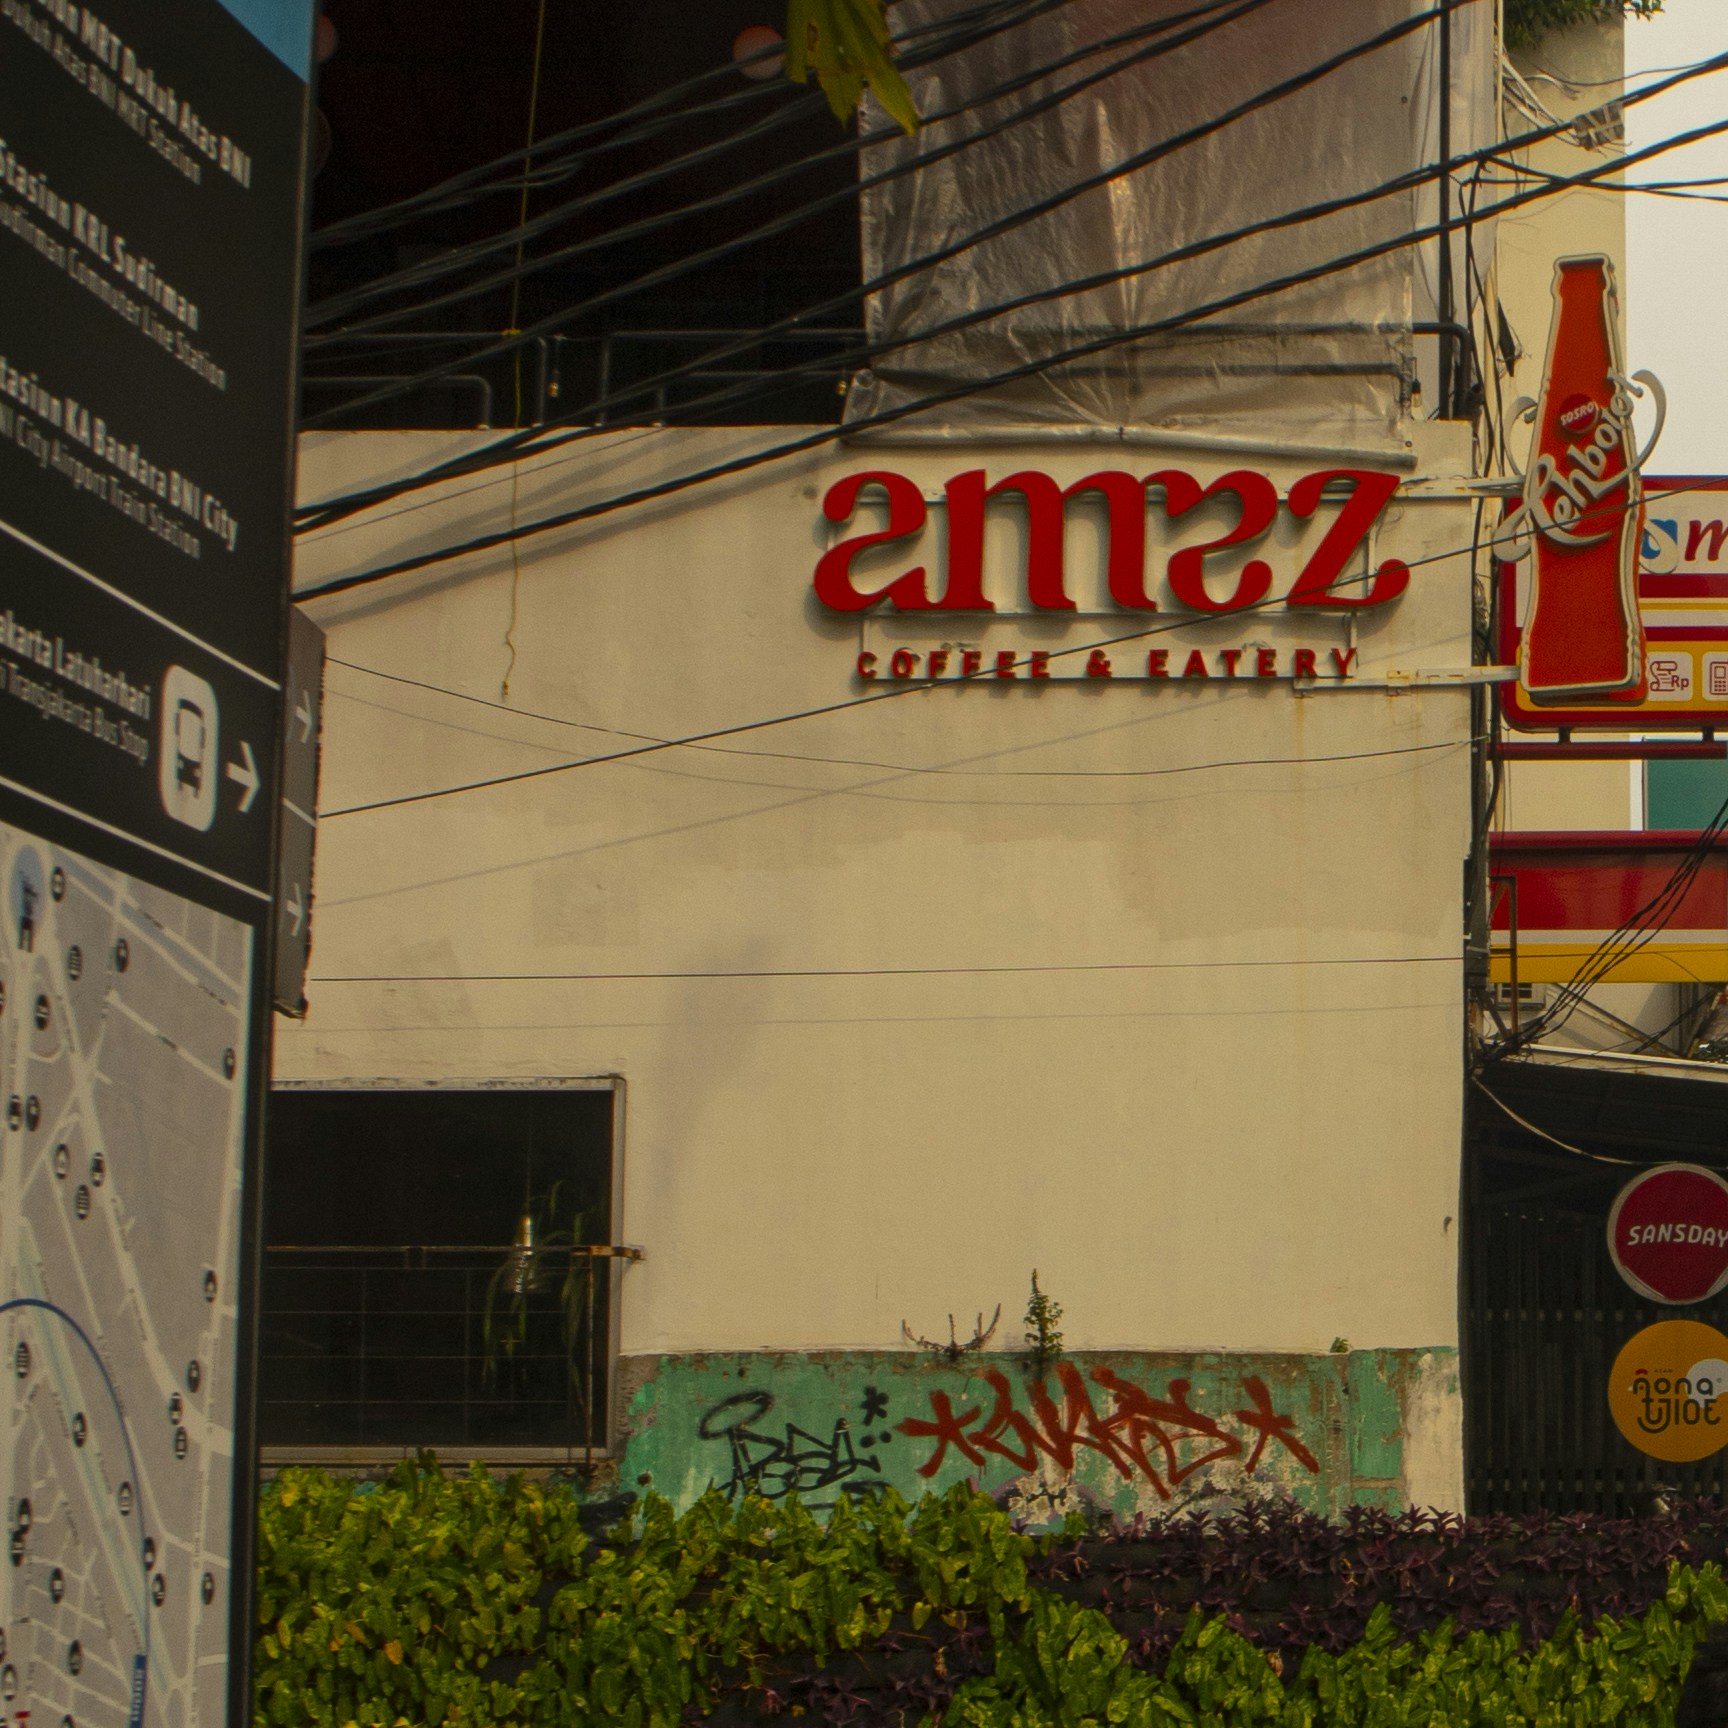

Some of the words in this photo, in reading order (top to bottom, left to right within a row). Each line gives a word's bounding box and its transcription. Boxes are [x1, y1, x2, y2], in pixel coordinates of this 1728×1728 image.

[79, 8, 122, 72] MRT
[120, 44, 178, 127] Dukuh
[178, 101, 218, 160] Atas
[219, 135, 252, 189] BNI
[147, 117, 201, 184] Station
[73, 201, 111, 263] KRL
[113, 234, 199, 333] Sudirman
[142, 303, 174, 353] Line
[175, 329, 227, 392] Station
[1560, 401, 1600, 426] SOSRO
[50, 437, 107, 503] Airport
[108, 474, 146, 526] Train
[147, 501, 200, 560] Station
[64, 397, 91, 450] KA
[92, 415, 168, 499] Bandara
[168, 469, 201, 522] BNI
[203, 491, 239, 554] City
[857, 649, 1052, 680] COFFEE
[1085, 649, 1114, 679] &
[1149, 648, 1359, 680] EATERY
[1671, 675, 1690, 690] Rp
